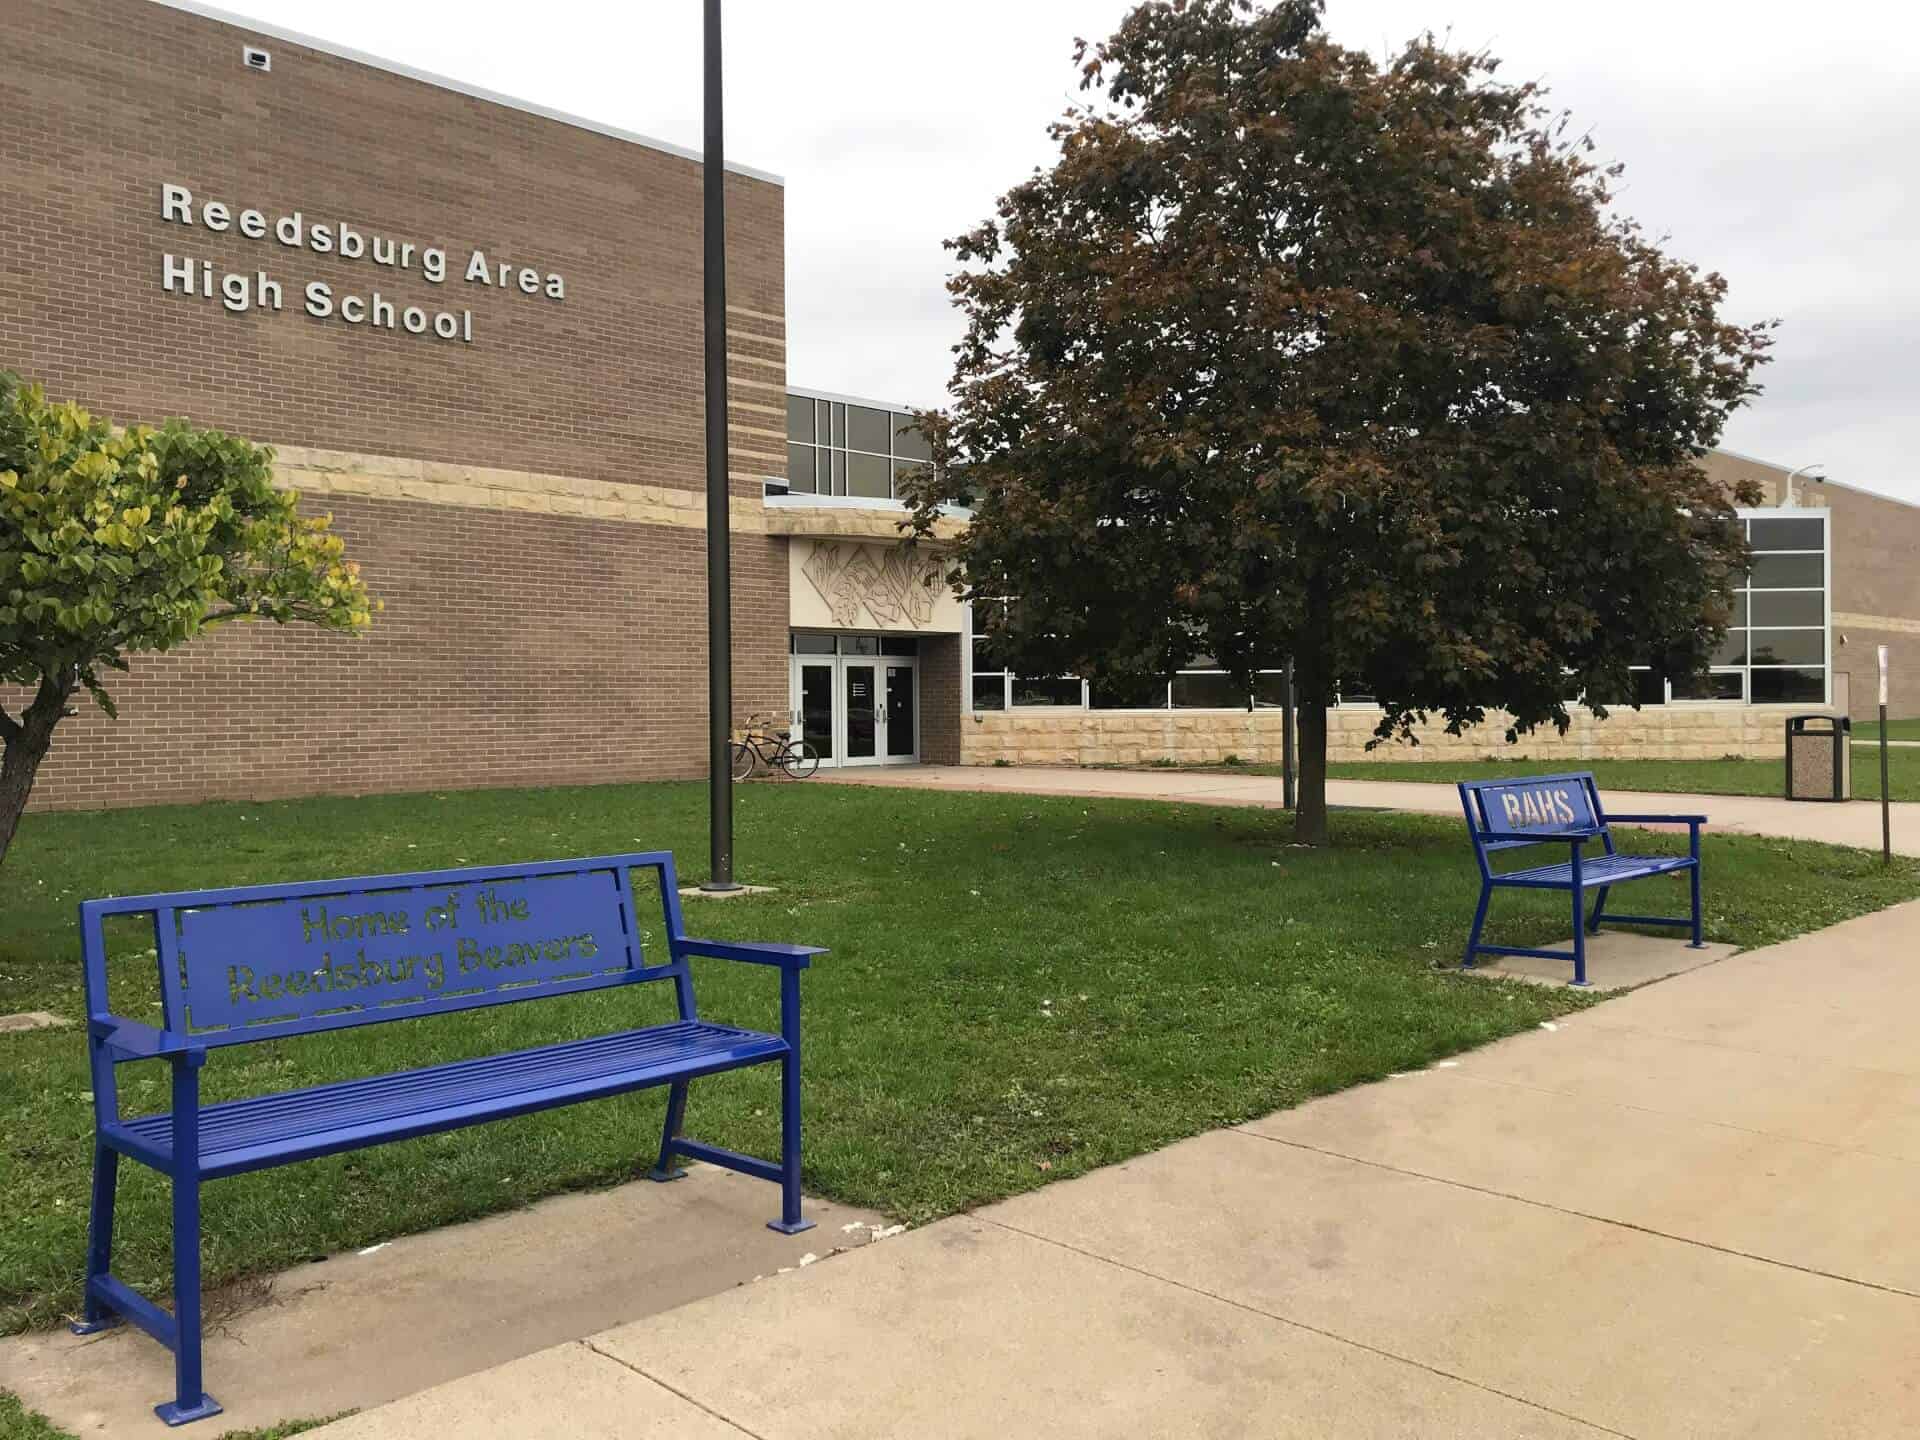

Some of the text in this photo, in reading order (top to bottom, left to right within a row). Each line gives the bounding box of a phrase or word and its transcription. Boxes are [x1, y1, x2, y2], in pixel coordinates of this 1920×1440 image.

[161, 183, 565, 299] Reedsburg Area
[162, 254, 472, 342] High School
[1501, 789, 1575, 827] RAHS
[302, 888, 531, 944] Home of the
[227, 931, 599, 1001] Reedsburg Beavers
